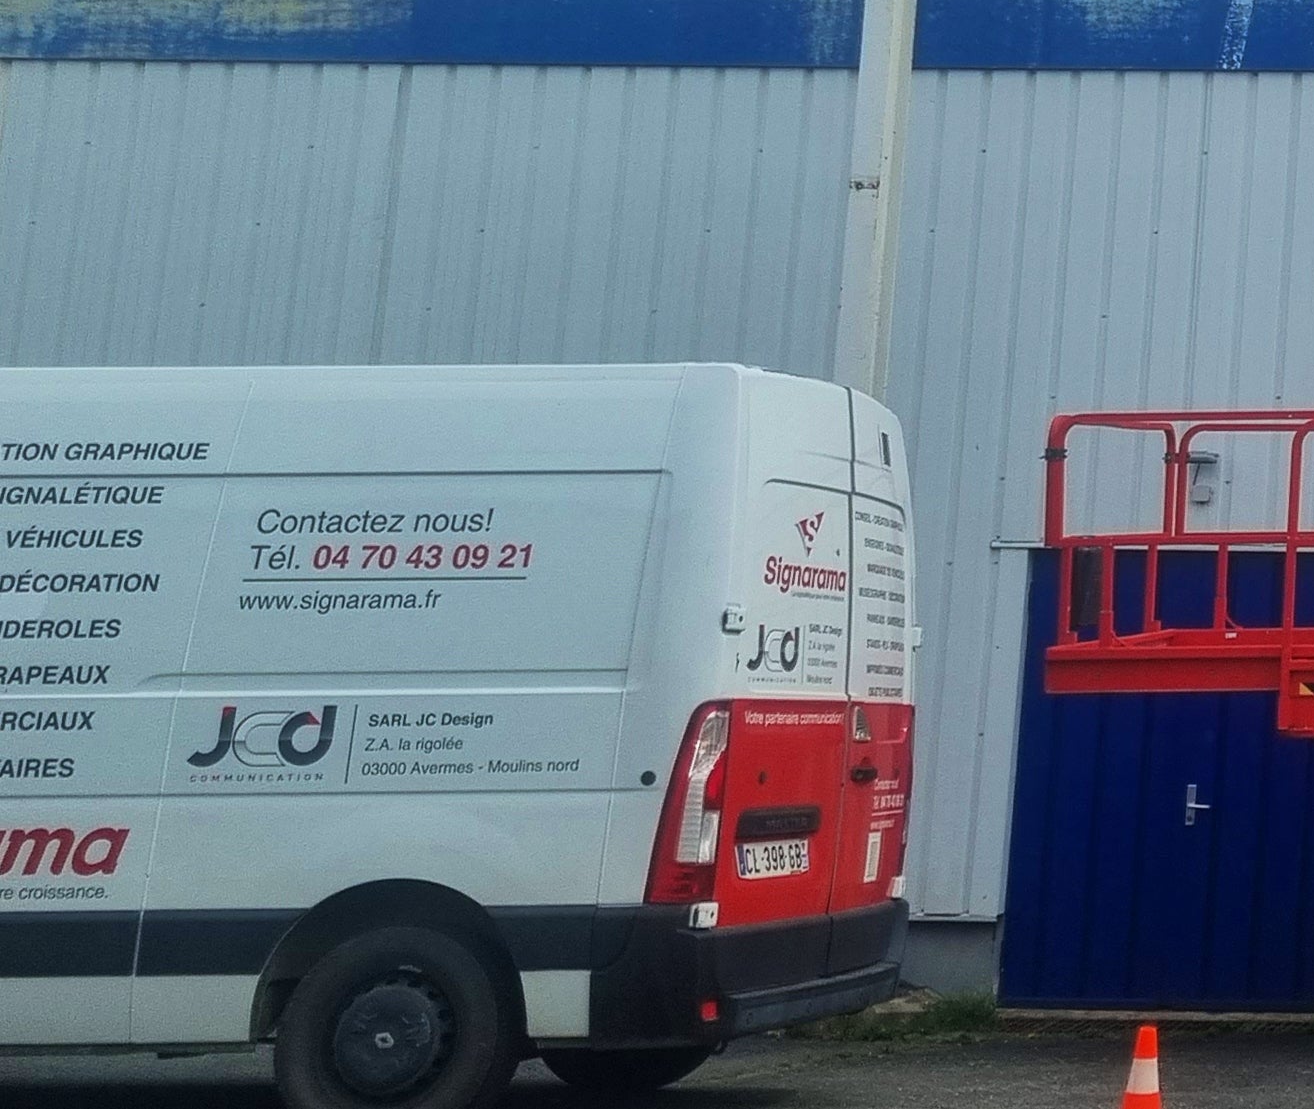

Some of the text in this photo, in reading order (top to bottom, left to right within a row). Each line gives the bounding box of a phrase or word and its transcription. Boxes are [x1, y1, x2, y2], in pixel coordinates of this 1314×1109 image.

[2, 442, 211, 461] TION GRAPHIQUE
[256, 508, 494, 534] Contactez nous!
[6, 525, 144, 549] VÉHICULES
[250, 543, 533, 571] Tél. 04 70 43 09 21
[0, 569, 161, 593] DÉCORATION
[763, 556, 848, 594] Signarama
[238, 589, 442, 615] www.signarama.fr
[0, 619, 122, 639] DEROLES
[368, 712, 494, 729] SARL JC Design
[364, 736, 463, 754] Z.A. la rigolée
[0, 758, 75, 778] AIRES
[361, 762, 407, 776] 03000
[410, 761, 474, 775] Avermes
[487, 759, 543, 774] Moulins
[546, 758, 580, 773] nord
[189, 773, 325, 783] COMMUNICATION
[0, 827, 130, 876] ma
[18, 884, 109, 900] croissance.
